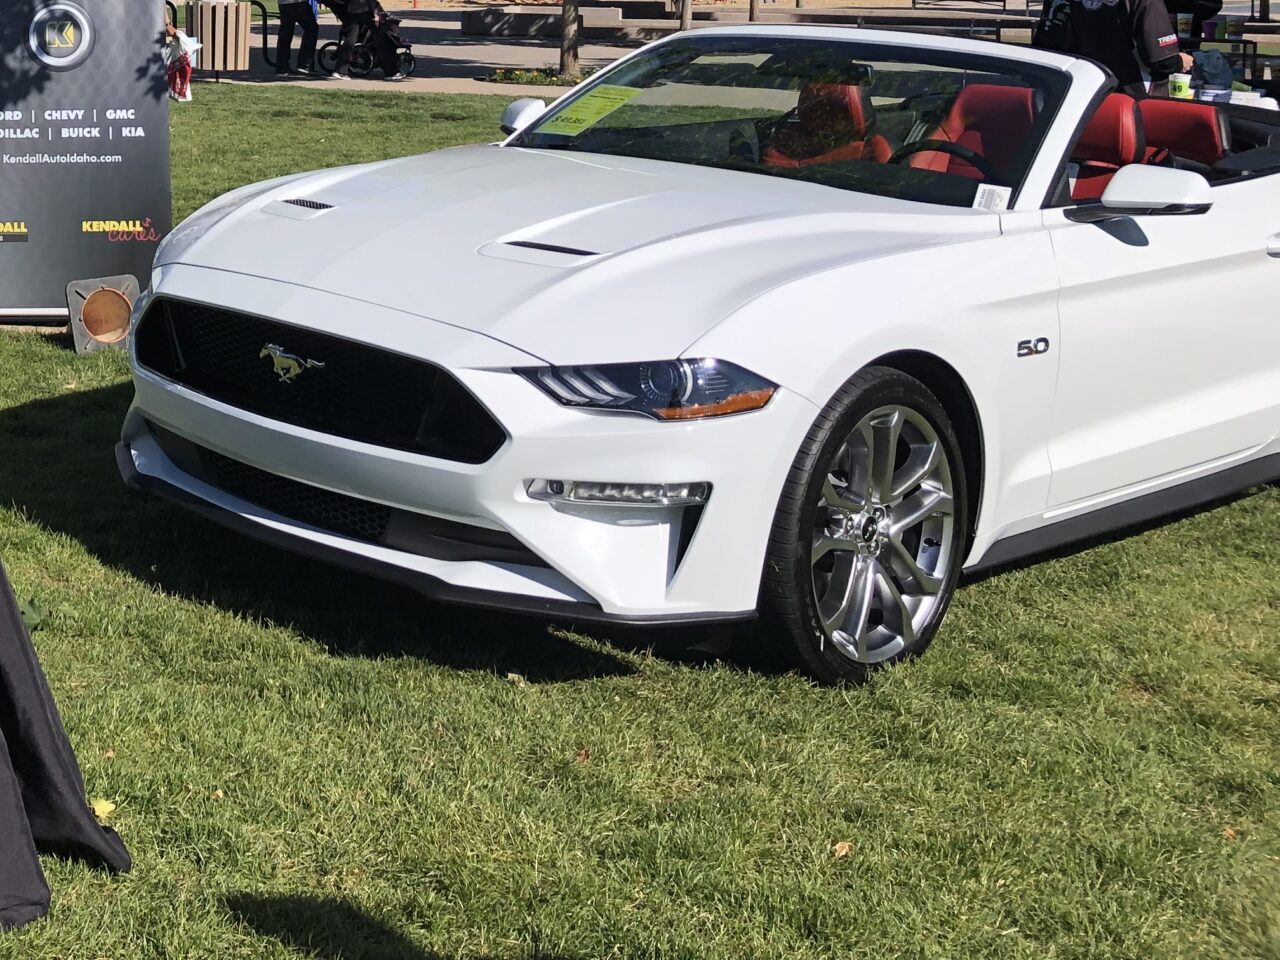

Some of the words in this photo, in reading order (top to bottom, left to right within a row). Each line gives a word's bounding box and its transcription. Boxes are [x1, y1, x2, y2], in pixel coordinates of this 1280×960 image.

[44, 110, 85, 121] CHEVY
[105, 109, 135, 120] GMC
[61, 127, 100, 138] BUICK
[121, 126, 145, 137] KIA
[3, 153, 122, 164] KendallAutoIdaho.com
[82, 221, 144, 232] KENDALL
